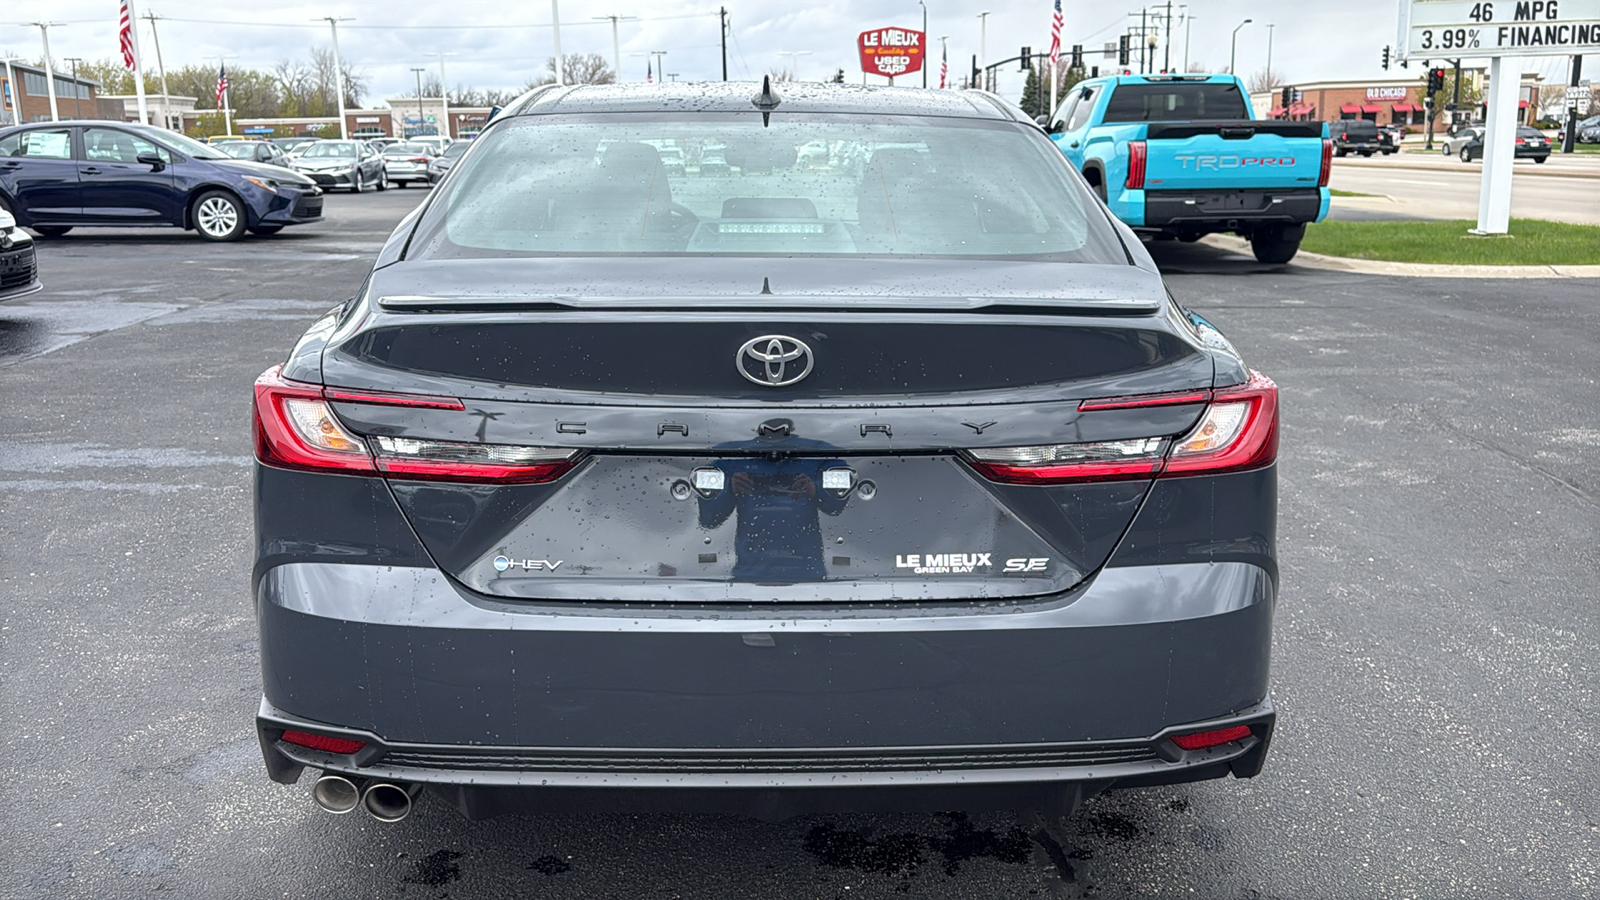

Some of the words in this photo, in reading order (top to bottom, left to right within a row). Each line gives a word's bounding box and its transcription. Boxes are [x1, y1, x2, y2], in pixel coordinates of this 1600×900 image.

[1469, 3, 1494, 22] 46
[1514, 1, 1558, 21] MPG
[864, 32, 878, 46] LE
[881, 29, 919, 46] MIEUX
[1421, 29, 1480, 49] 3.99%
[1498, 25, 1600, 46] FINANCING
[874, 56, 910, 65] USED
[878, 65, 906, 74] CARS
[1366, 88, 1379, 98] OLD
[1380, 87, 1407, 97] CHICAGO
[1174, 154, 1239, 171] TRD
[1241, 157, 1296, 168] PRO
[556, 421, 998, 438] CAMRY
[509, 558, 564, 570] HEV
[896, 554, 920, 567] LE
[926, 553, 992, 567] MIEUX
[1002, 557, 1050, 573] SE
[914, 566, 949, 574] GREEN
